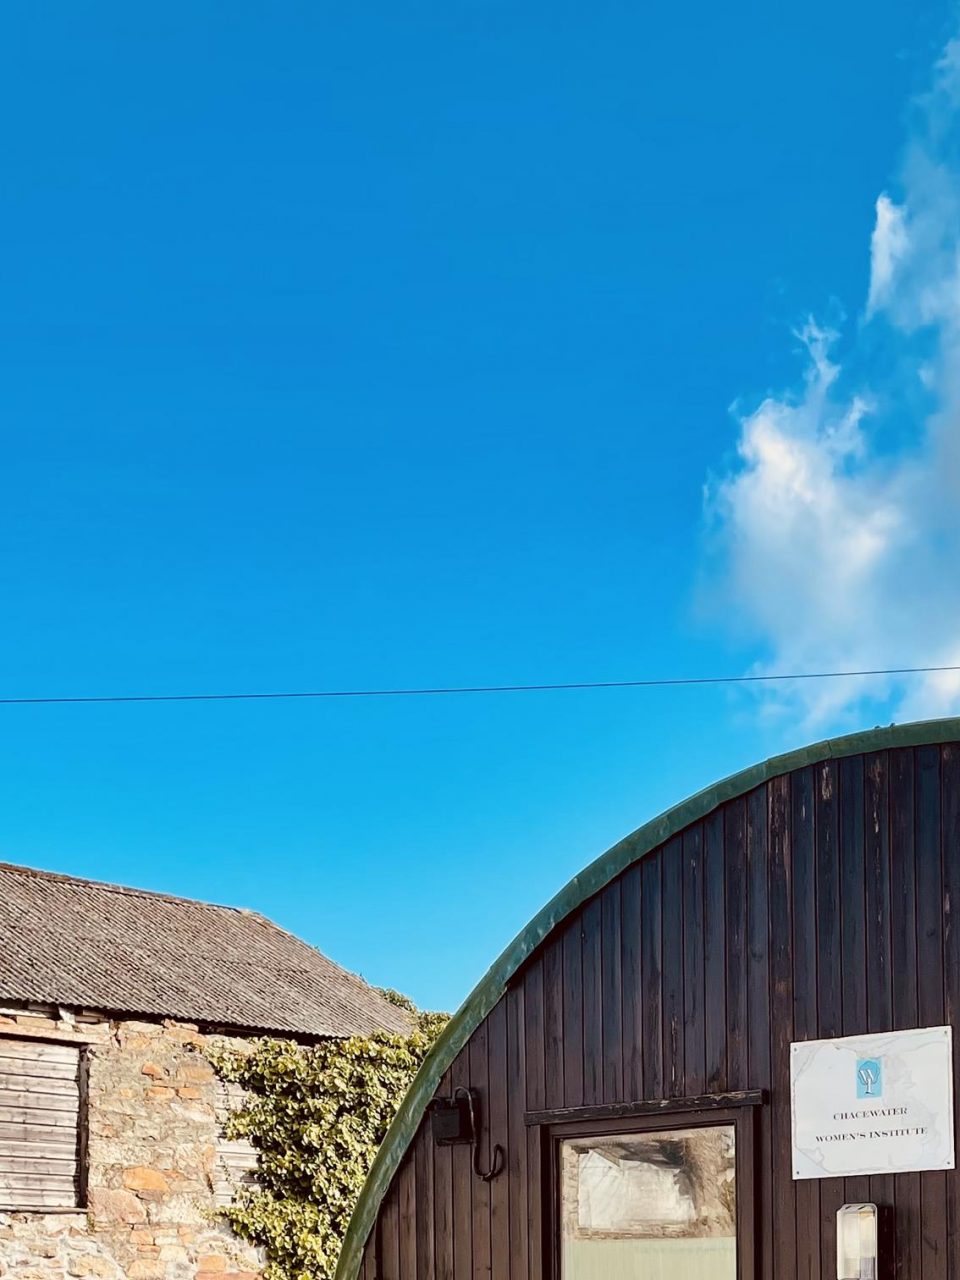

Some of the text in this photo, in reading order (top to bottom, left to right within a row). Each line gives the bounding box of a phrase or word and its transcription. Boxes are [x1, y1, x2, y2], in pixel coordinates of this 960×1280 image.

[833, 1107, 908, 1121] CHACEWATER
[815, 1127, 928, 1143] WOMEN'S INSTITUTE
